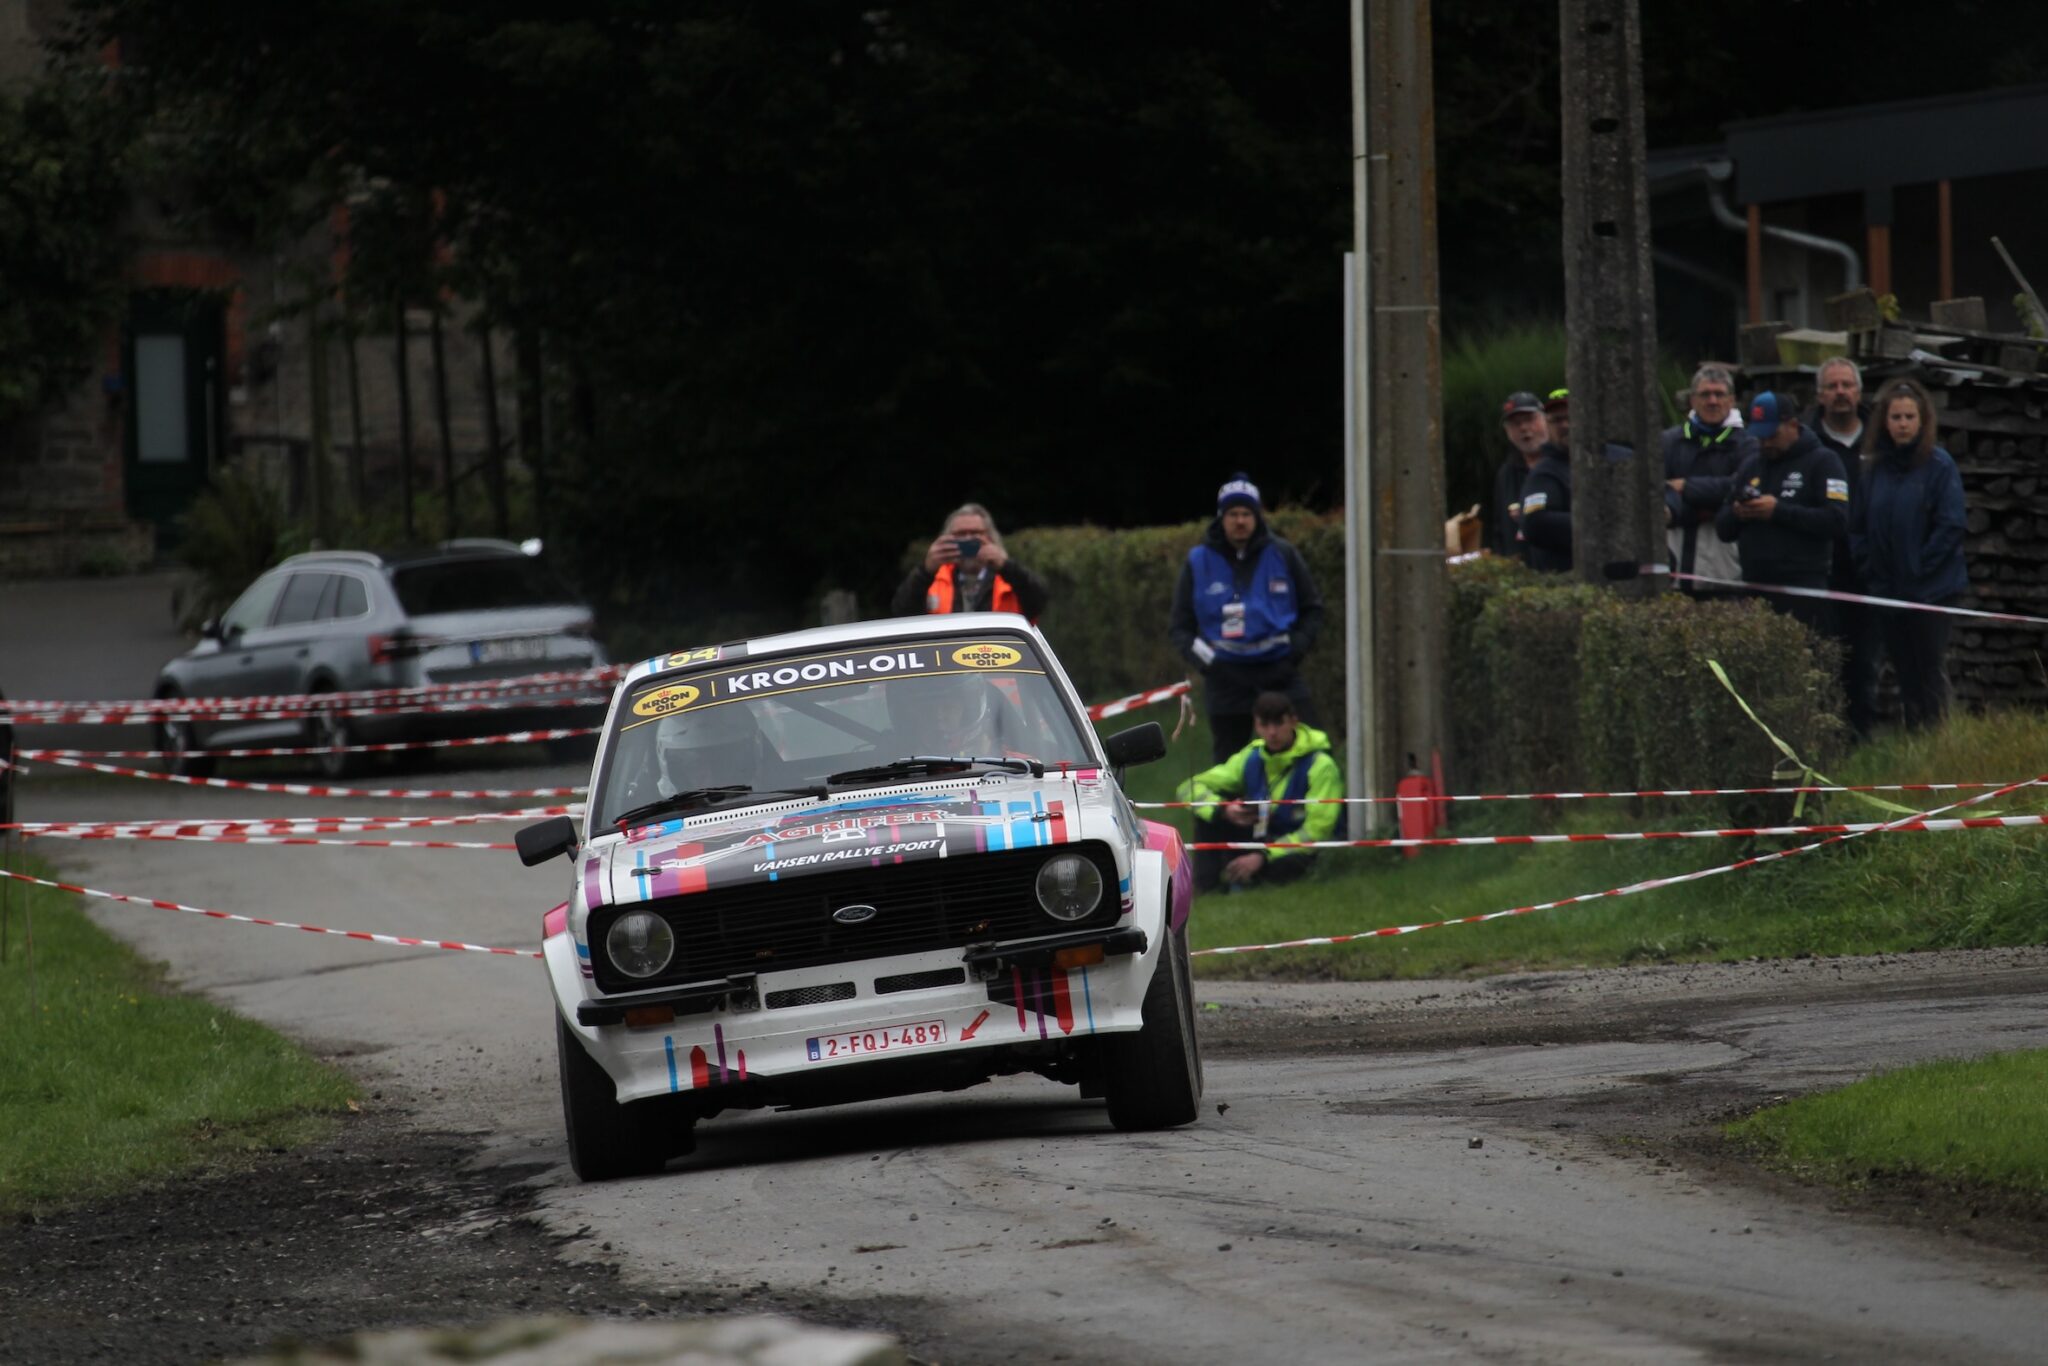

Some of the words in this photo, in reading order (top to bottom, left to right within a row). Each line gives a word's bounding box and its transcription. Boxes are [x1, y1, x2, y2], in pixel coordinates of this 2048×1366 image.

[961, 652, 1012, 660] KROON
[728, 652, 925, 694] KROON-OIL
[642, 691, 690, 711] KROON
[655, 702, 677, 713] OIL
[741, 809, 944, 847] AGRIFER
[753, 852, 820, 873] VAHSEN
[823, 846, 883, 861] RALLYE
[885, 838, 941, 854] SPORT
[826, 1024, 941, 1057] 2-FQJ-489
[811, 1051, 818, 1060] B
